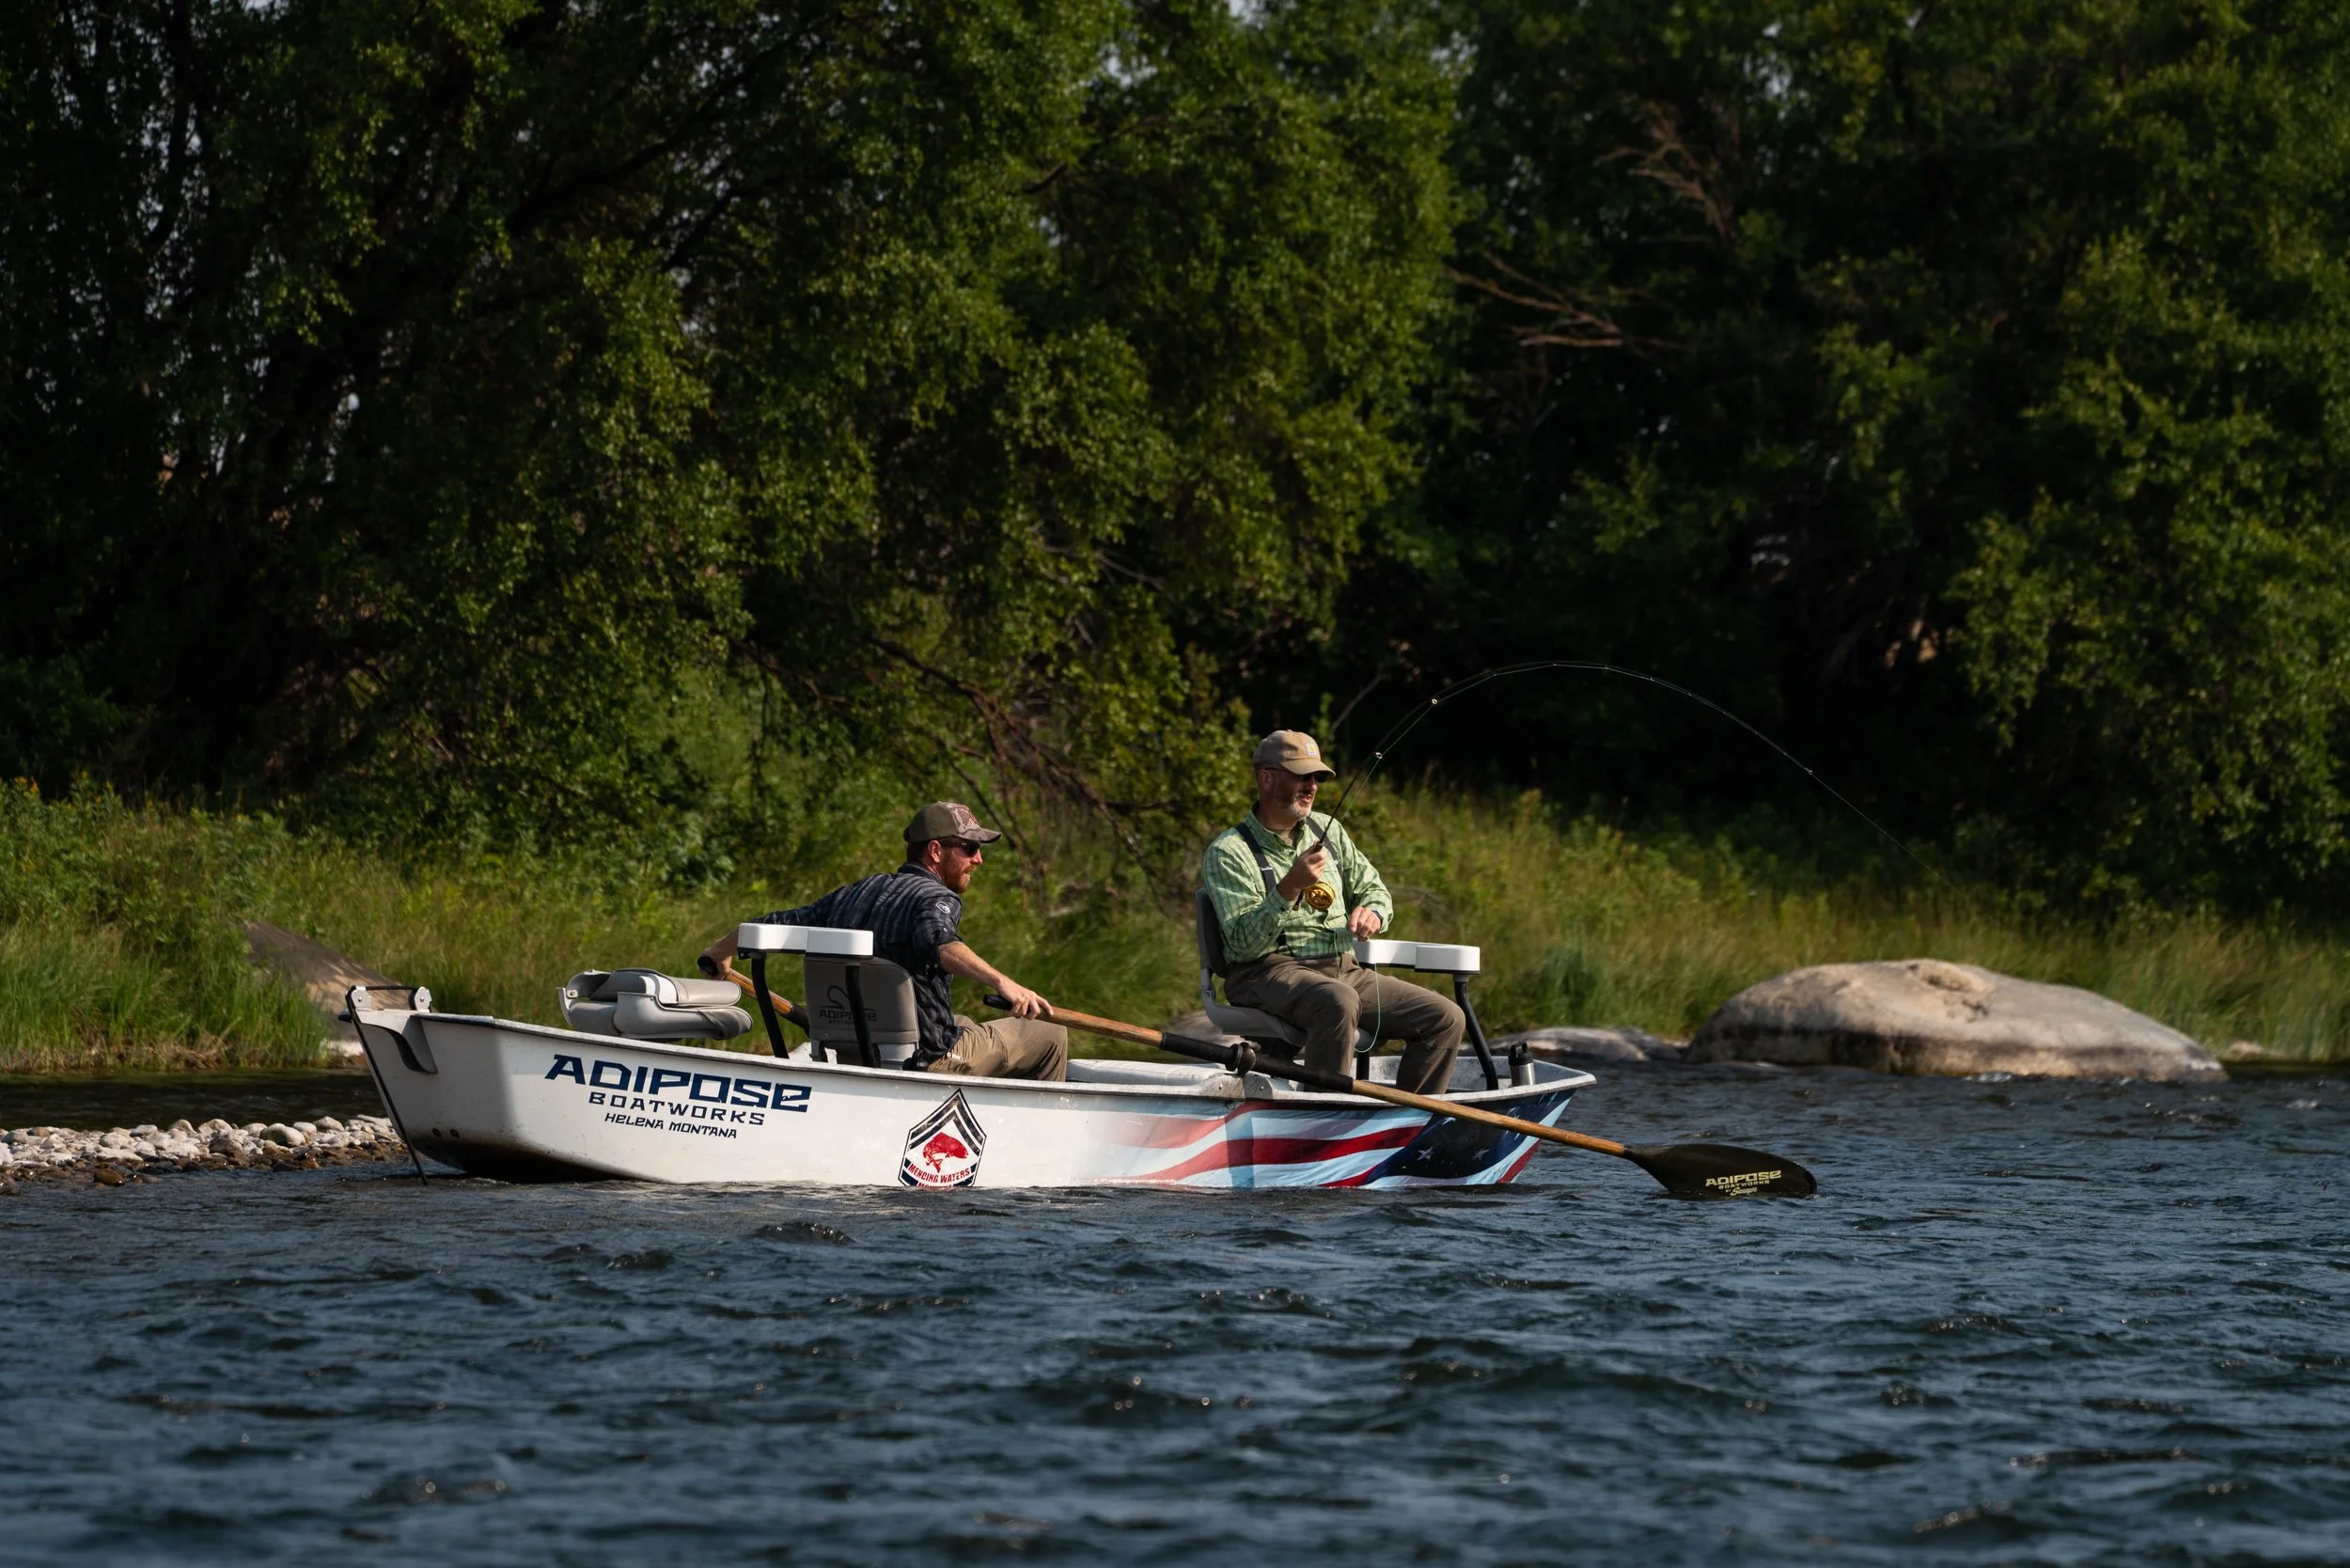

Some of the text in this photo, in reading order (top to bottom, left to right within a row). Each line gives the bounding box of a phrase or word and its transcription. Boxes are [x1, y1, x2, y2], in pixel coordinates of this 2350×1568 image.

[544, 1054, 811, 1113] ADIPOSE
[588, 1091, 765, 1125] BOATWORKS
[604, 1112, 737, 1138] HELENA MONTANA
[940, 1168, 970, 1184] WATERS
[1705, 1170, 1781, 1186] ADIPOSE
[1718, 1180, 1770, 1189] BOATWORKS
